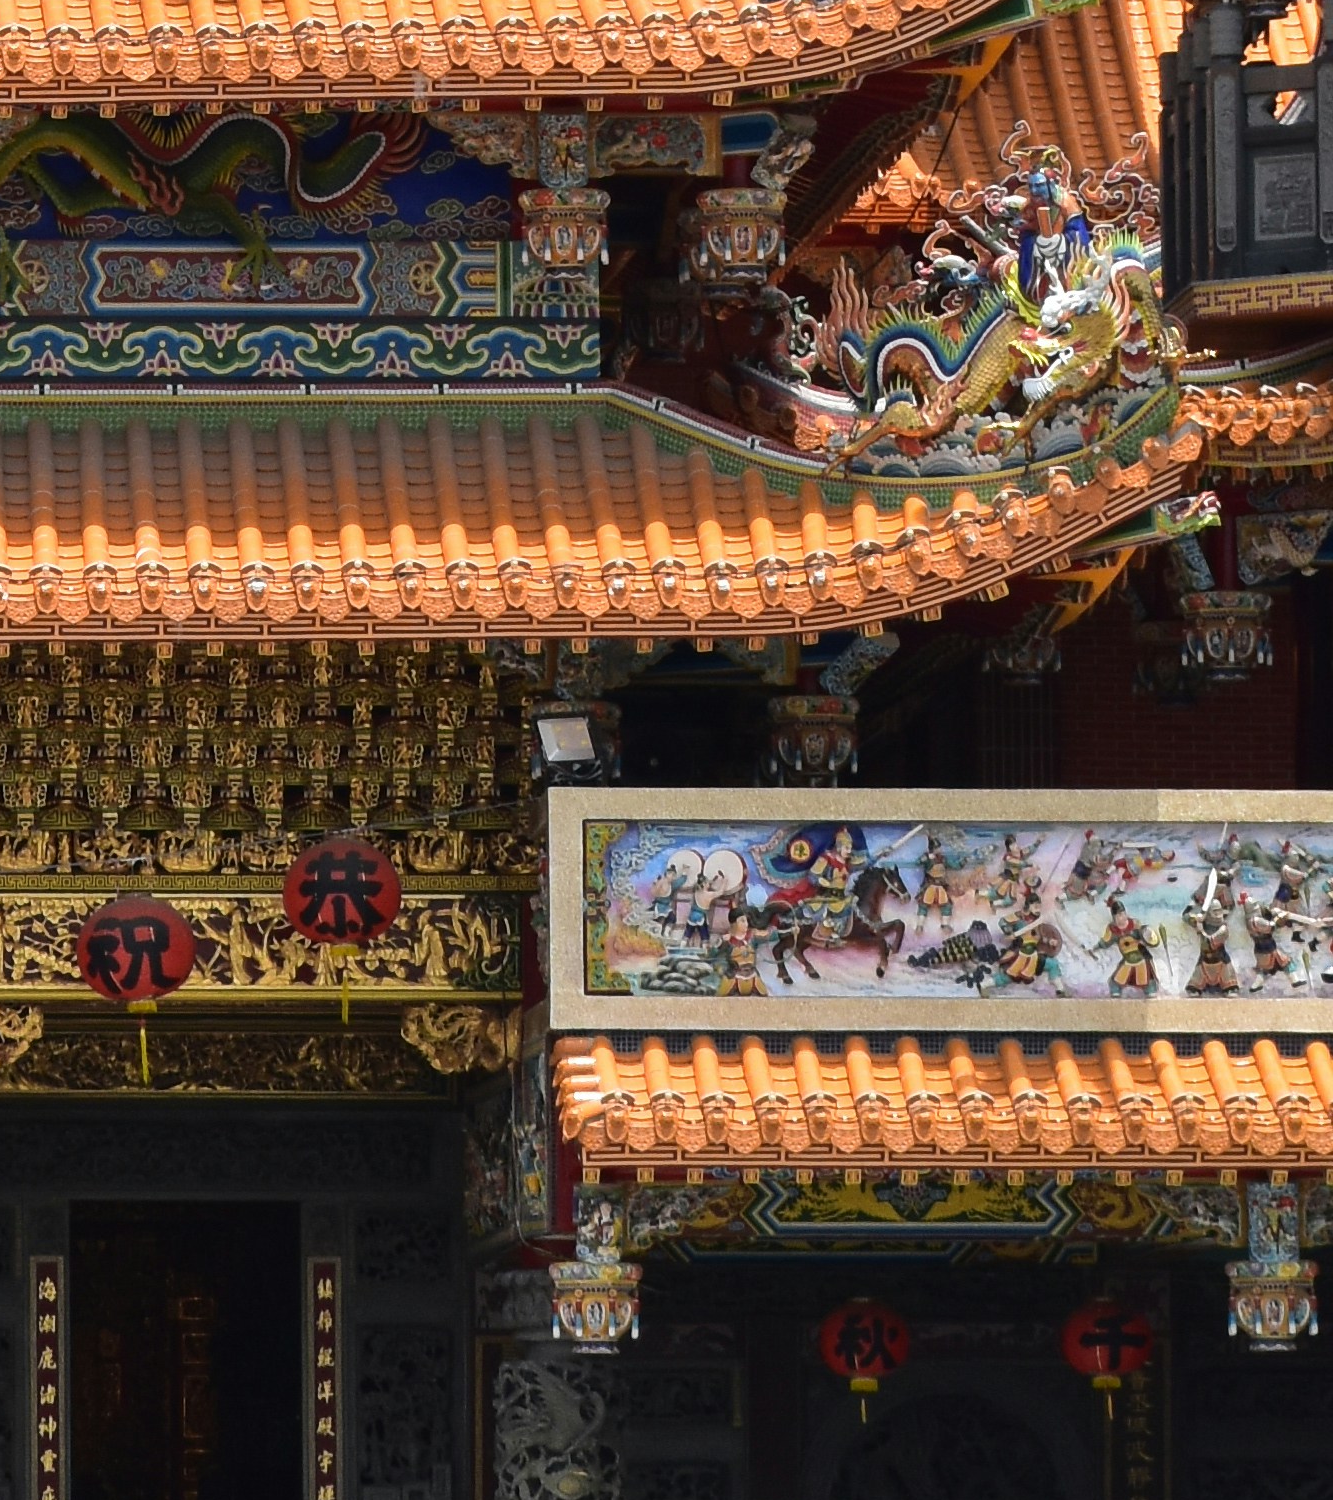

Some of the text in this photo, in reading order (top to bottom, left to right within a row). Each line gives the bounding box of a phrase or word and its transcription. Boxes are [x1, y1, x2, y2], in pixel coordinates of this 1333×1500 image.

[299, 850, 384, 939] 恭
[86, 916, 181, 995] 祝
[835, 1314, 899, 1370] 秋
[1080, 1313, 1146, 1370] 千
